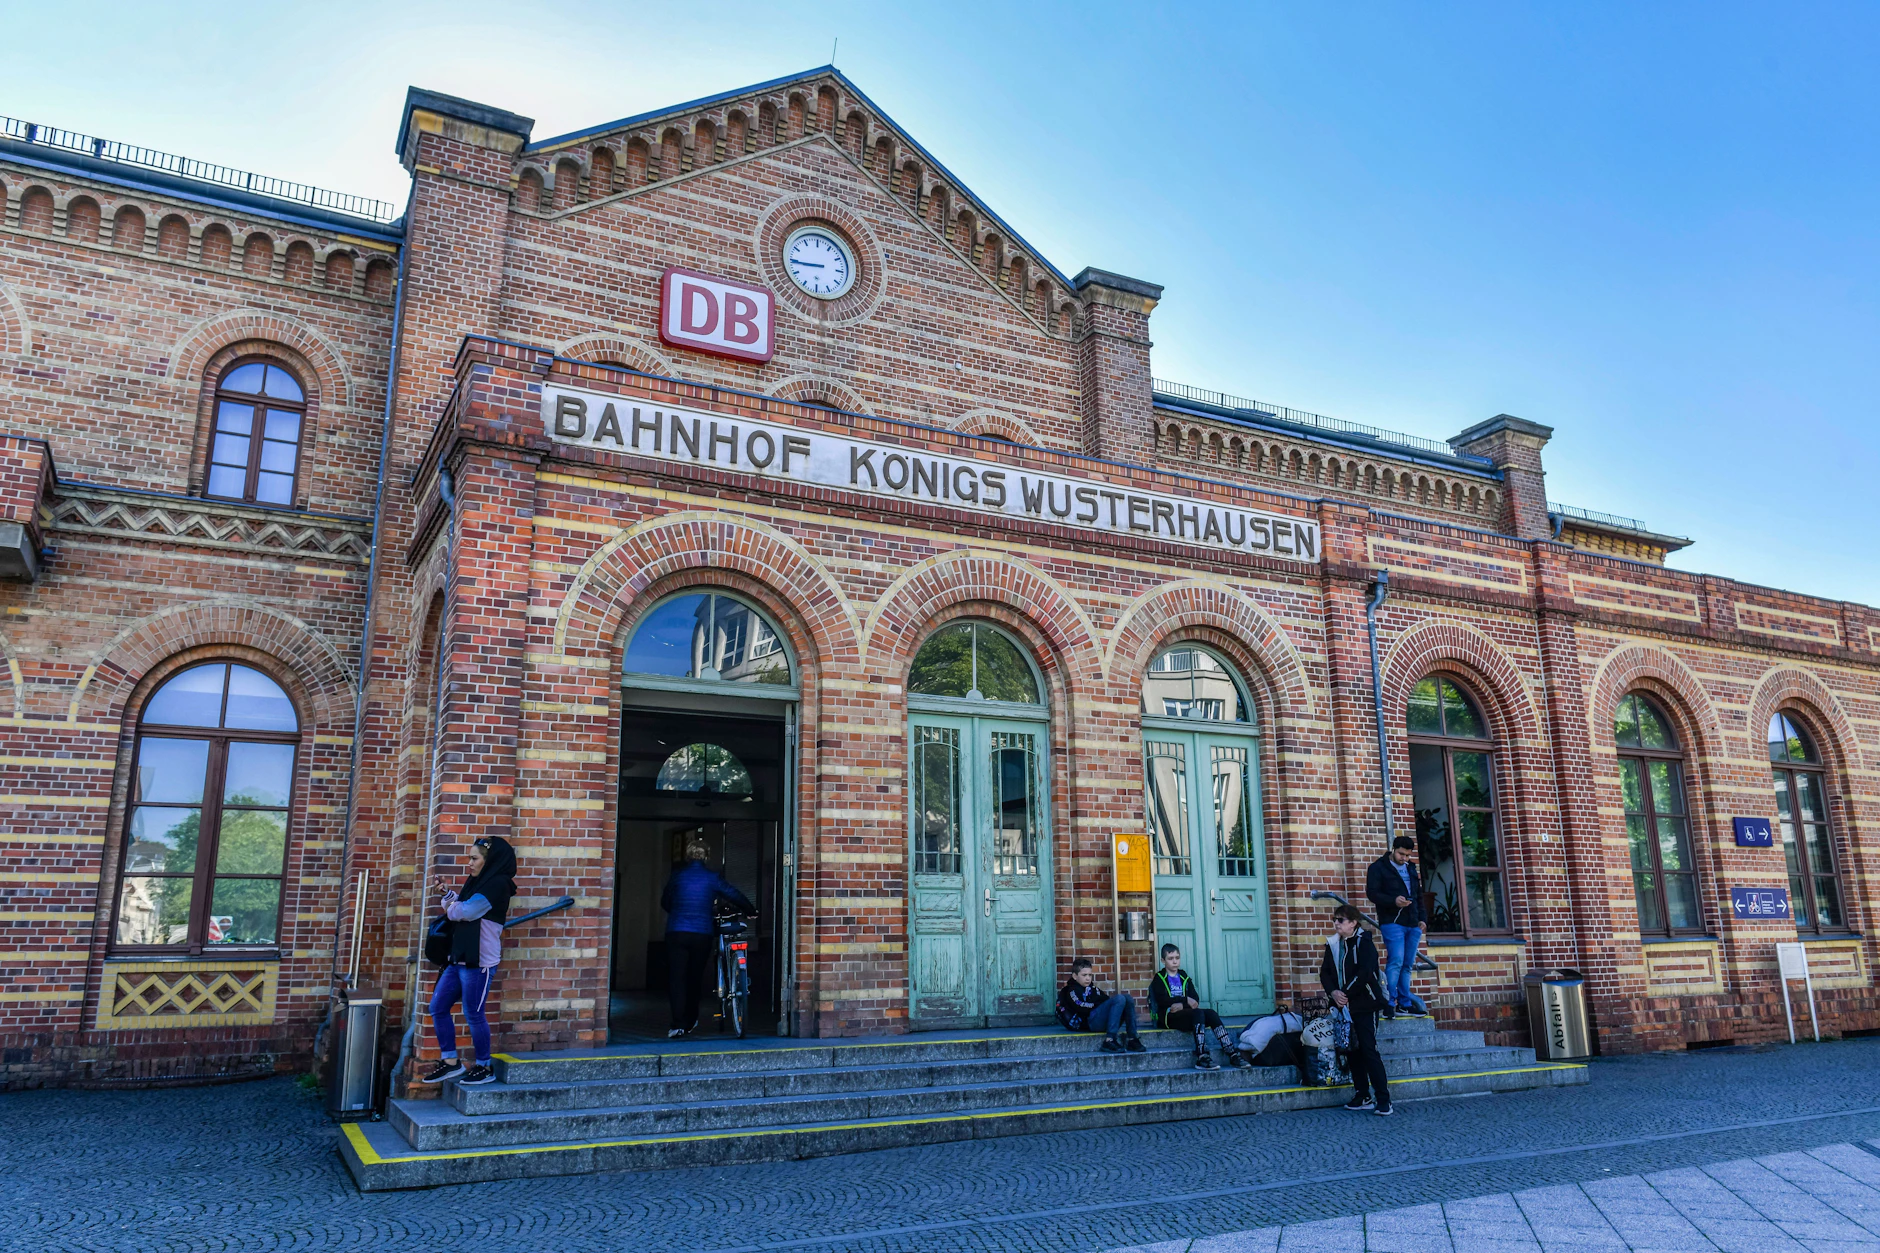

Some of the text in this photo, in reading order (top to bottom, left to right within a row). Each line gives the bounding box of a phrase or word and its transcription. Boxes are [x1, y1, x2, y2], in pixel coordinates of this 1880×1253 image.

[680, 283, 760, 345] DB
[555, 395, 1315, 557] BAHNHOF KÖNIGS WUSTERHAUSEN
[1309, 1022, 1325, 1034] wie
[1551, 1004, 1565, 1049] Abfall
